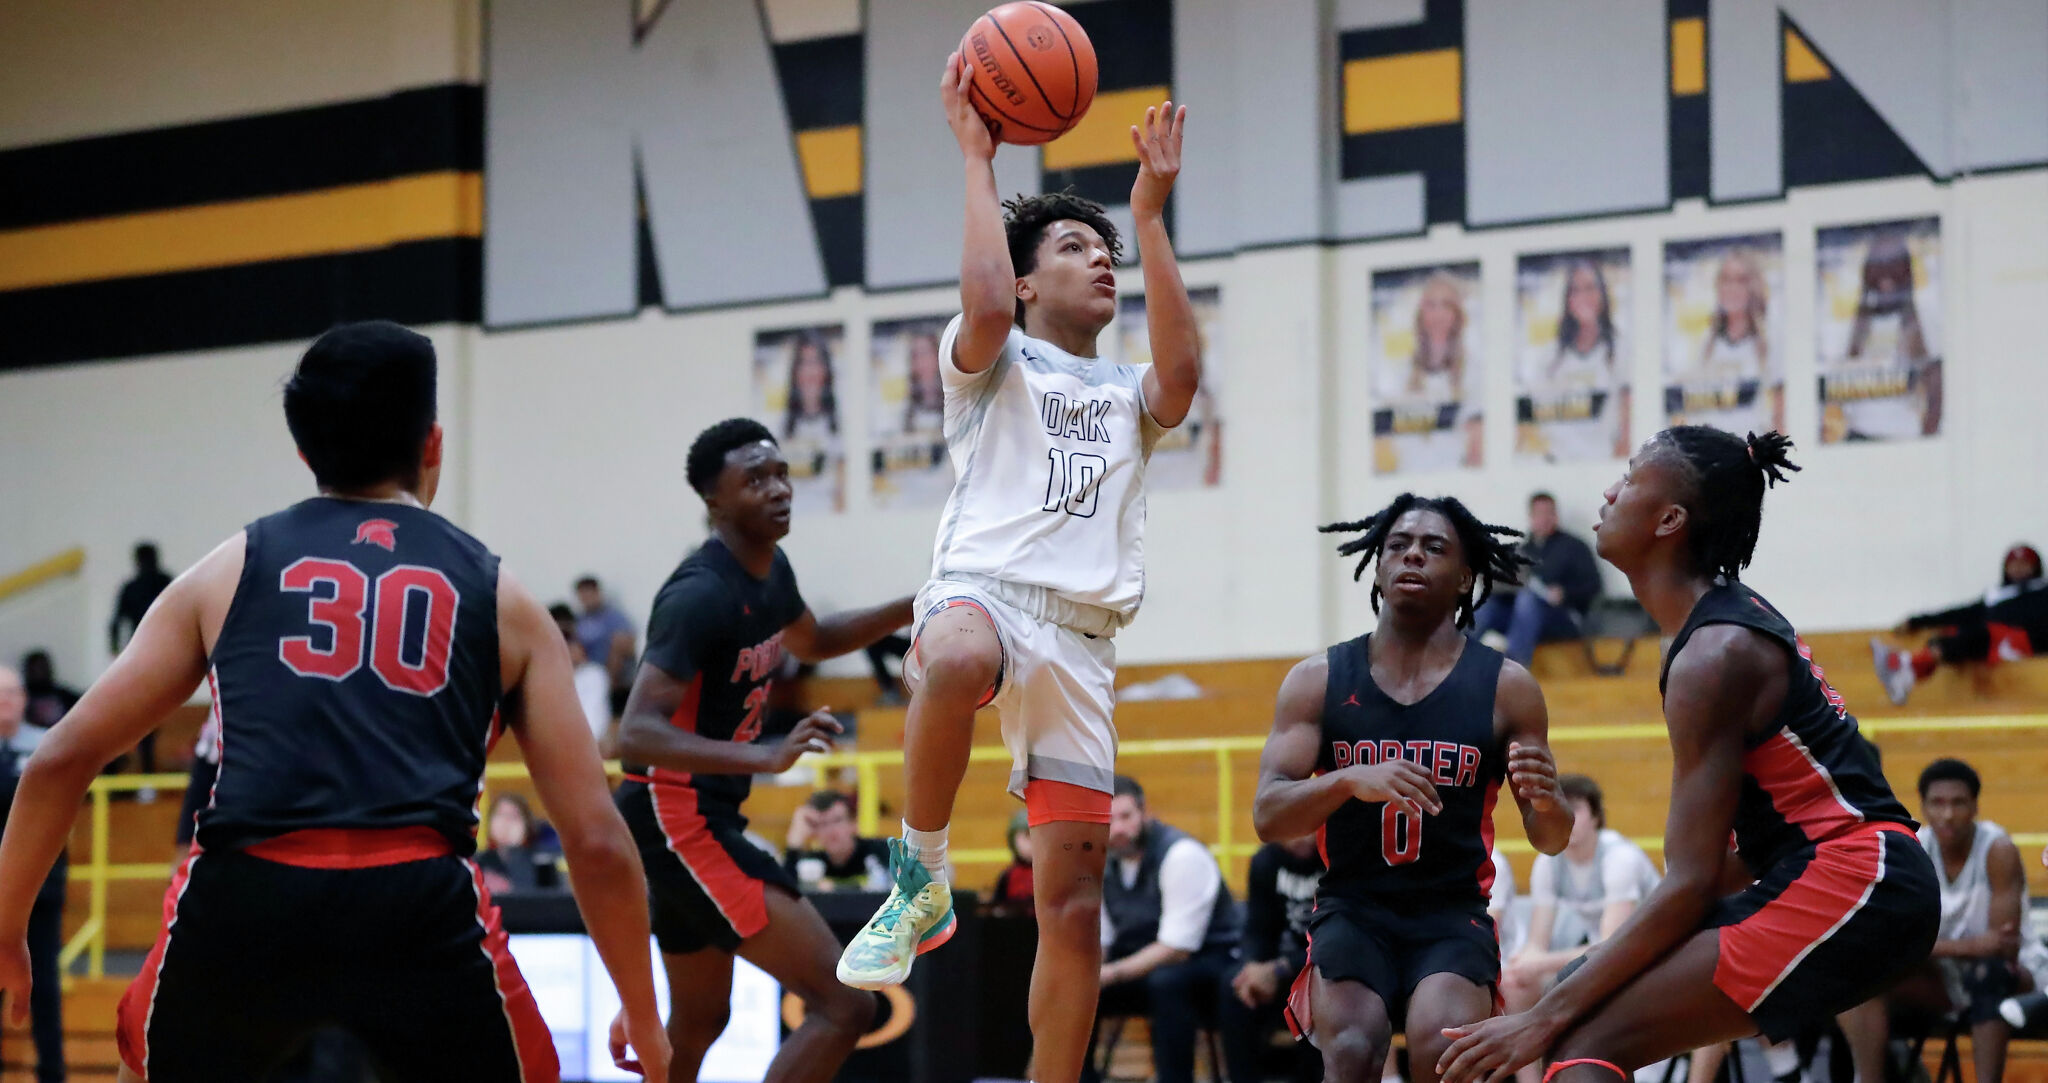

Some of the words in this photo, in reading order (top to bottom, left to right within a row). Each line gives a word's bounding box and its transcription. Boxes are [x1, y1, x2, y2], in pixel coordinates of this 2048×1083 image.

[971, 32, 1025, 106] EVOLUTION
[1042, 391, 1112, 443] OAK
[1042, 447, 1107, 518] 10
[279, 556, 460, 697] 30
[1381, 796, 1423, 867] 0
